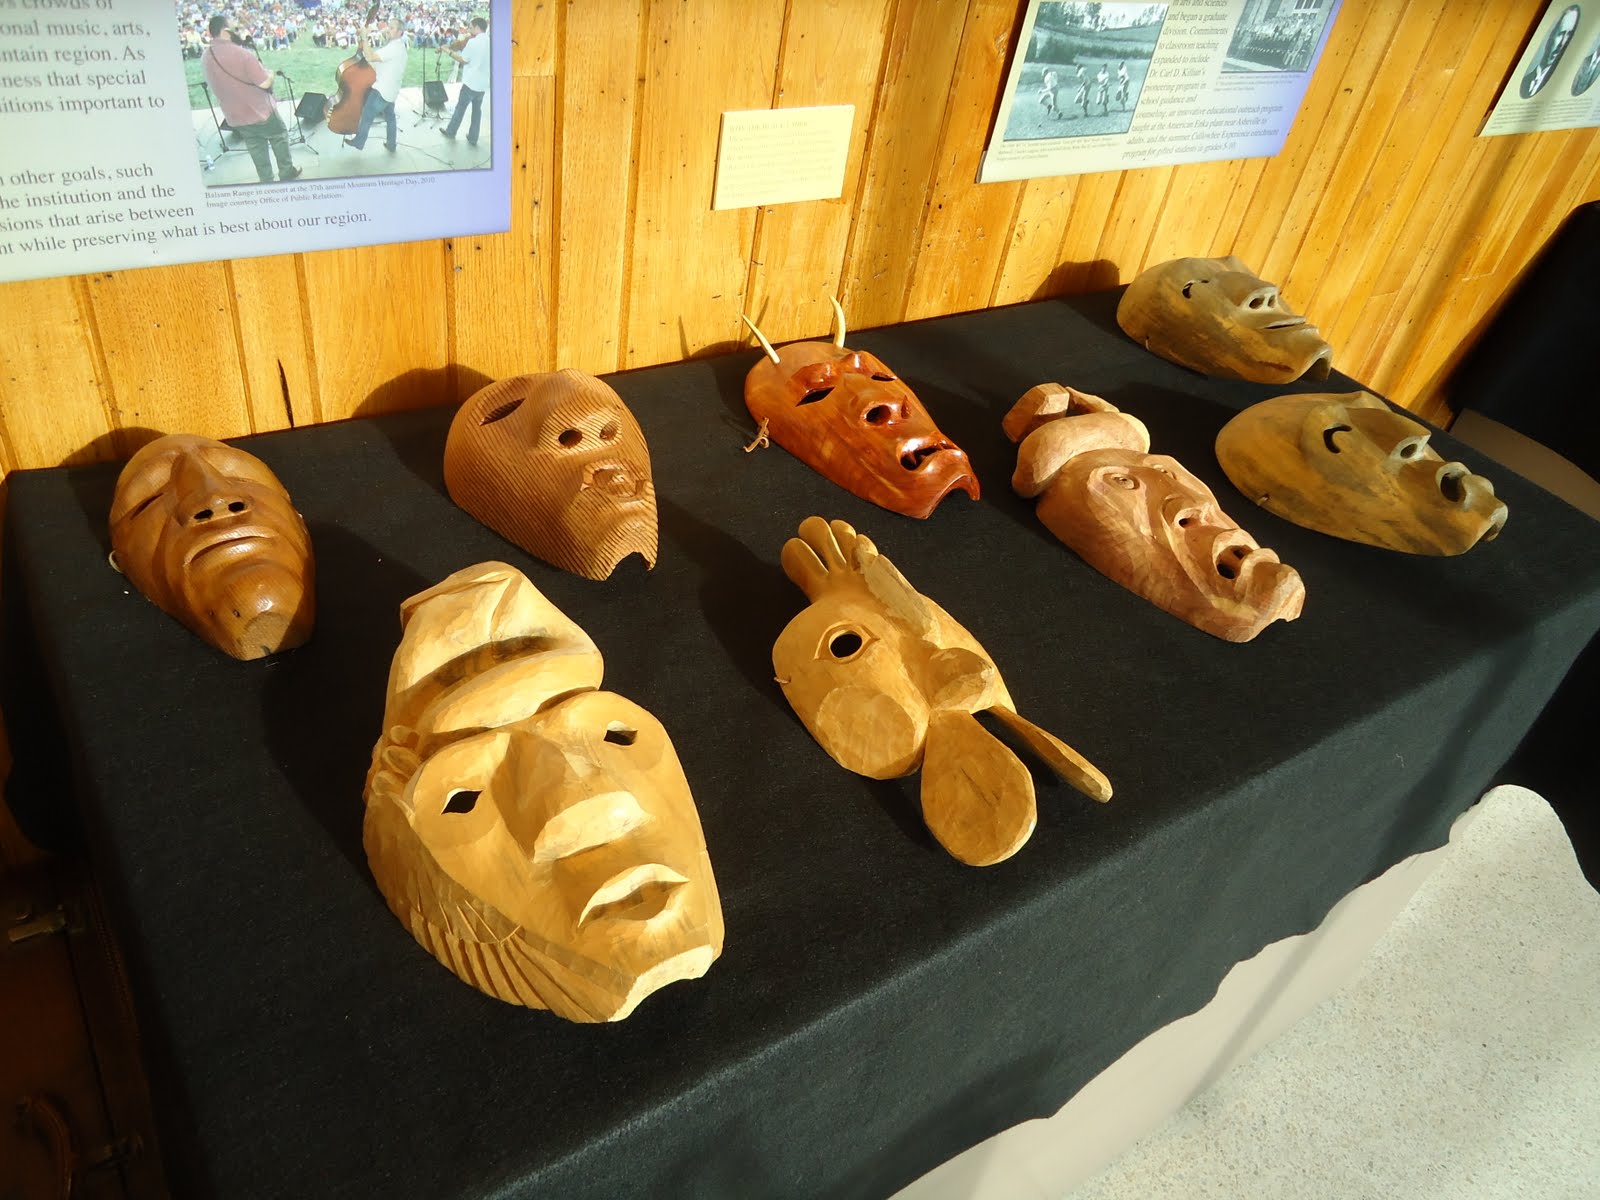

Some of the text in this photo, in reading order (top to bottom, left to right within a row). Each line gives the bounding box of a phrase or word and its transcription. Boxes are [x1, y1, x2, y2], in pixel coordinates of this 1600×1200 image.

[23, 0, 90, 10] crowds
[0, 20, 150, 36] onal music, arts,
[55, 45, 118, 66] region.
[122, 45, 146, 62] As
[48, 72, 81, 87] that
[87, 70, 146, 90] special
[59, 96, 143, 114] important
[148, 96, 165, 108] to
[10, 170, 55, 186] other
[62, 166, 112, 186] goals,
[116, 163, 154, 178] such
[25, 188, 112, 208] institution
[116, 186, 147, 200] and
[152, 184, 176, 198] the
[204, 191, 230, 200] Balsam
[232, 190, 255, 199] Range
[264, 187, 288, 196] concert
[297, 184, 308, 192] the
[309, 184, 324, 192] 37th
[325, 182, 346, 190] annual
[347, 181, 378, 189] Mountain
[378, 178, 404, 188] Heritage
[230, 199, 258, 208] courtesy
[259, 196, 280, 204] Office
[290, 194, 311, 202] Public
[0, 206, 195, 233] sions that arise between
[20, 236, 67, 252] while
[72, 229, 158, 252] preserving
[160, 225, 198, 238] what
[203, 222, 216, 236] is
[220, 220, 250, 234] best
[254, 217, 293, 232] about
[298, 216, 321, 228] our
[325, 211, 372, 227] region.
